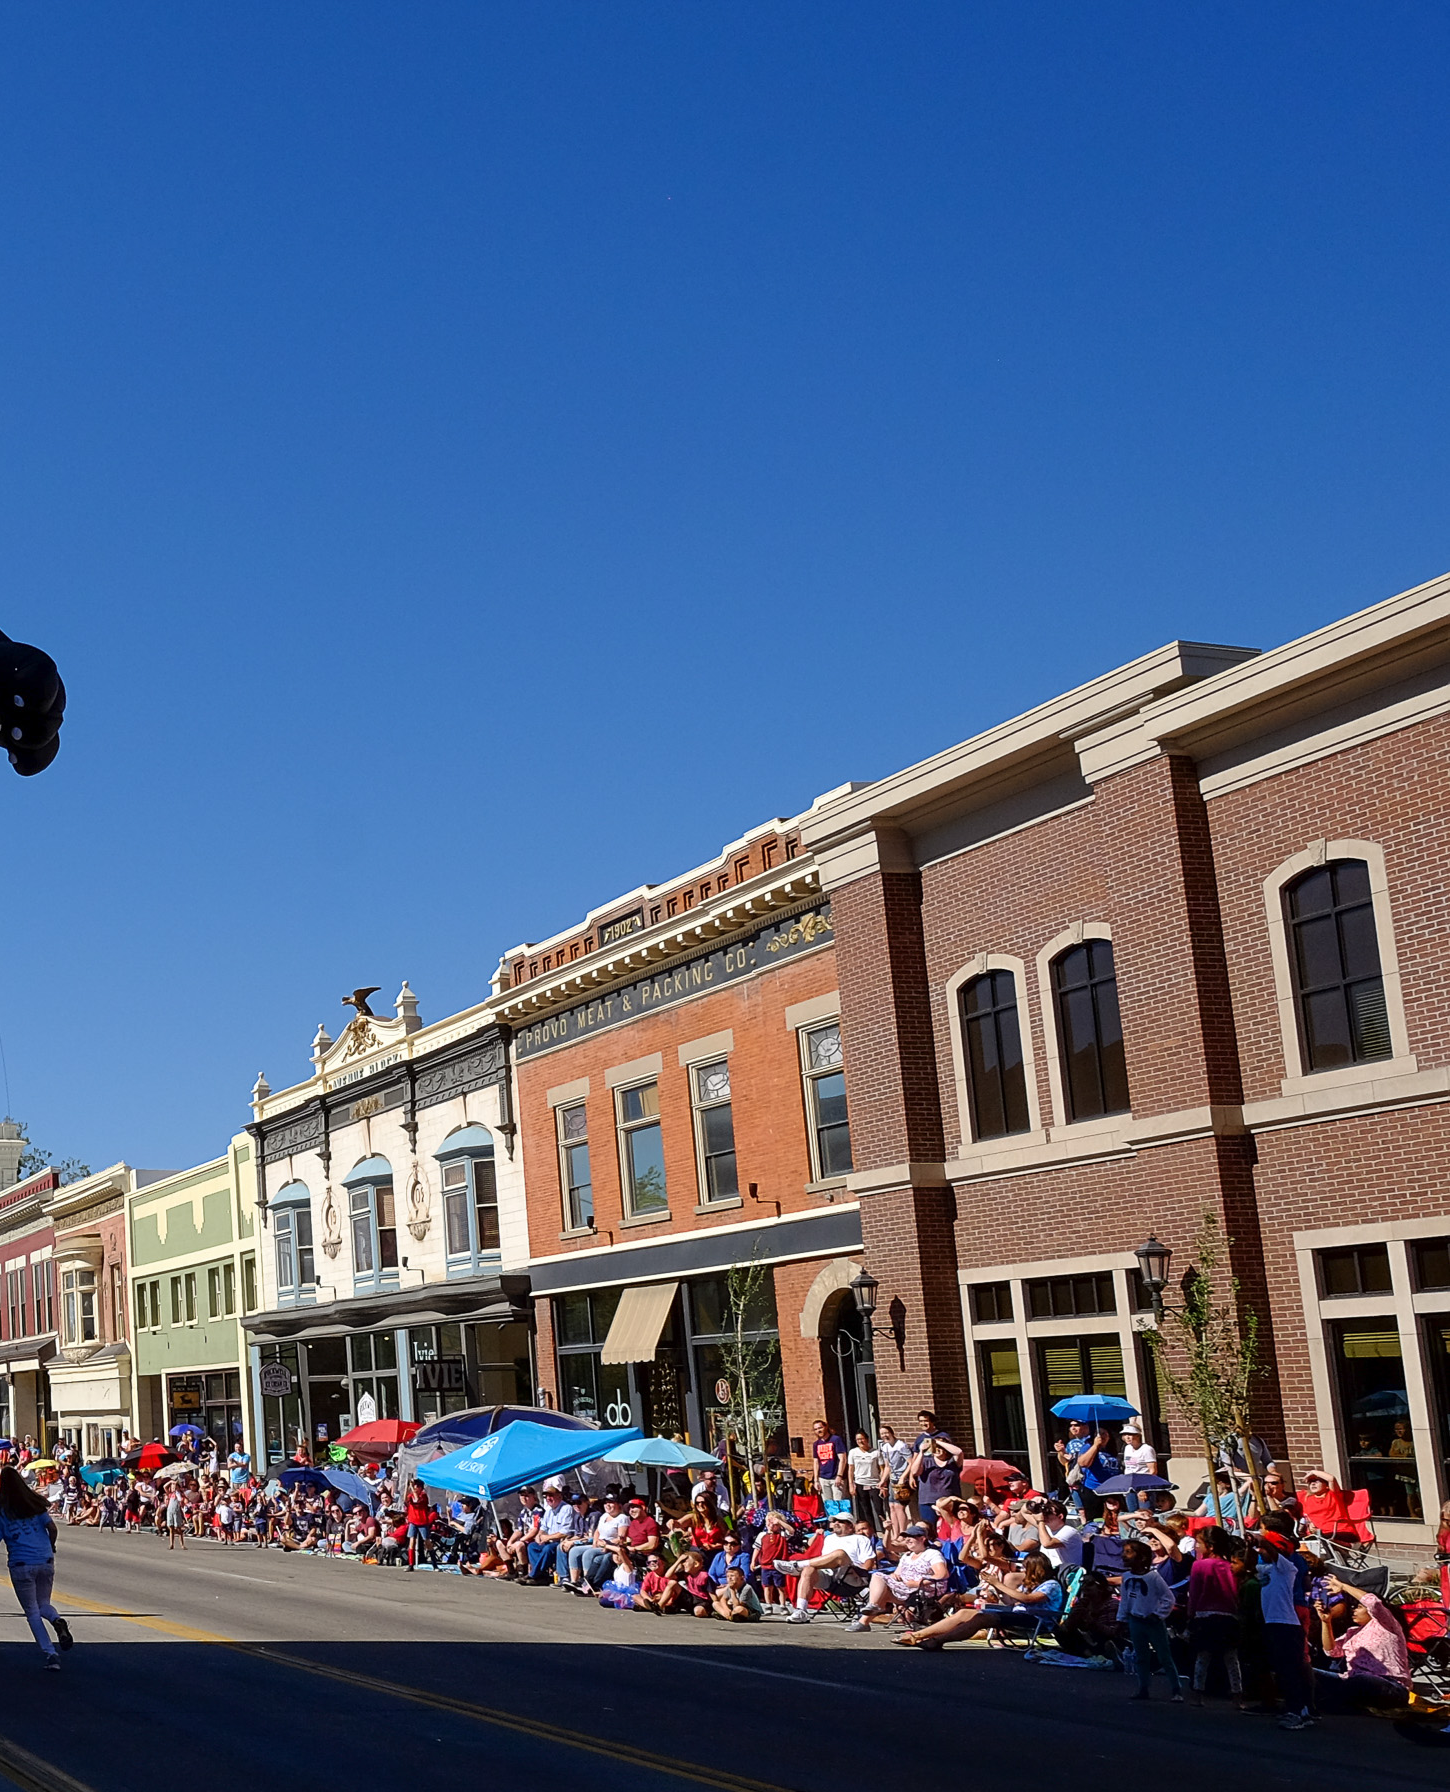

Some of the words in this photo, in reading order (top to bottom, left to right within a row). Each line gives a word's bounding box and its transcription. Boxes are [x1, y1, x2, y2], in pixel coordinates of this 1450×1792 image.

[611, 918, 633, 941] 1902
[526, 1018, 567, 1050] PROVO
[577, 1001, 613, 1030] MEAT
[622, 994, 633, 1012] &
[642, 961, 714, 1005] PACKING
[417, 1362, 463, 1389] IVIE
